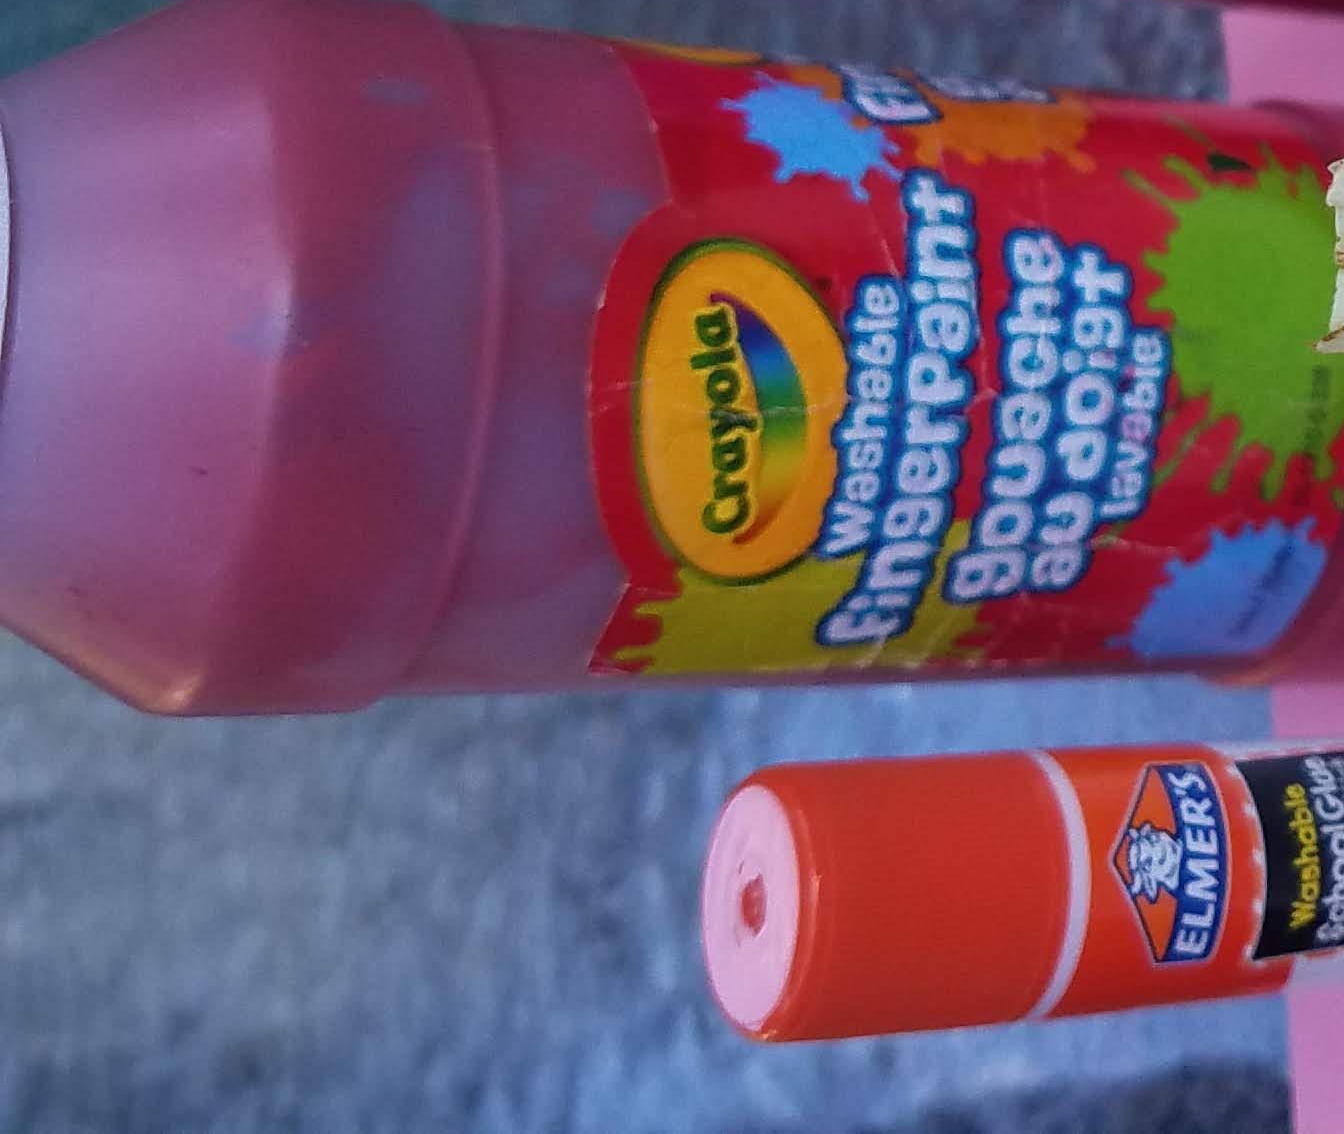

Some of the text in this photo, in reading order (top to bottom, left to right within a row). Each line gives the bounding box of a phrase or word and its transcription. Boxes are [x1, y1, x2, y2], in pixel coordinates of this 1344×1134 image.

[689, 306, 758, 533] Crayola
[826, 280, 900, 556] Washable
[951, 234, 1066, 600] gouache
[1030, 249, 1128, 588] au doigt
[1101, 332, 1162, 519] lavable
[1167, 769, 1220, 956] ELMER'S
[1283, 783, 1320, 932] Washable
